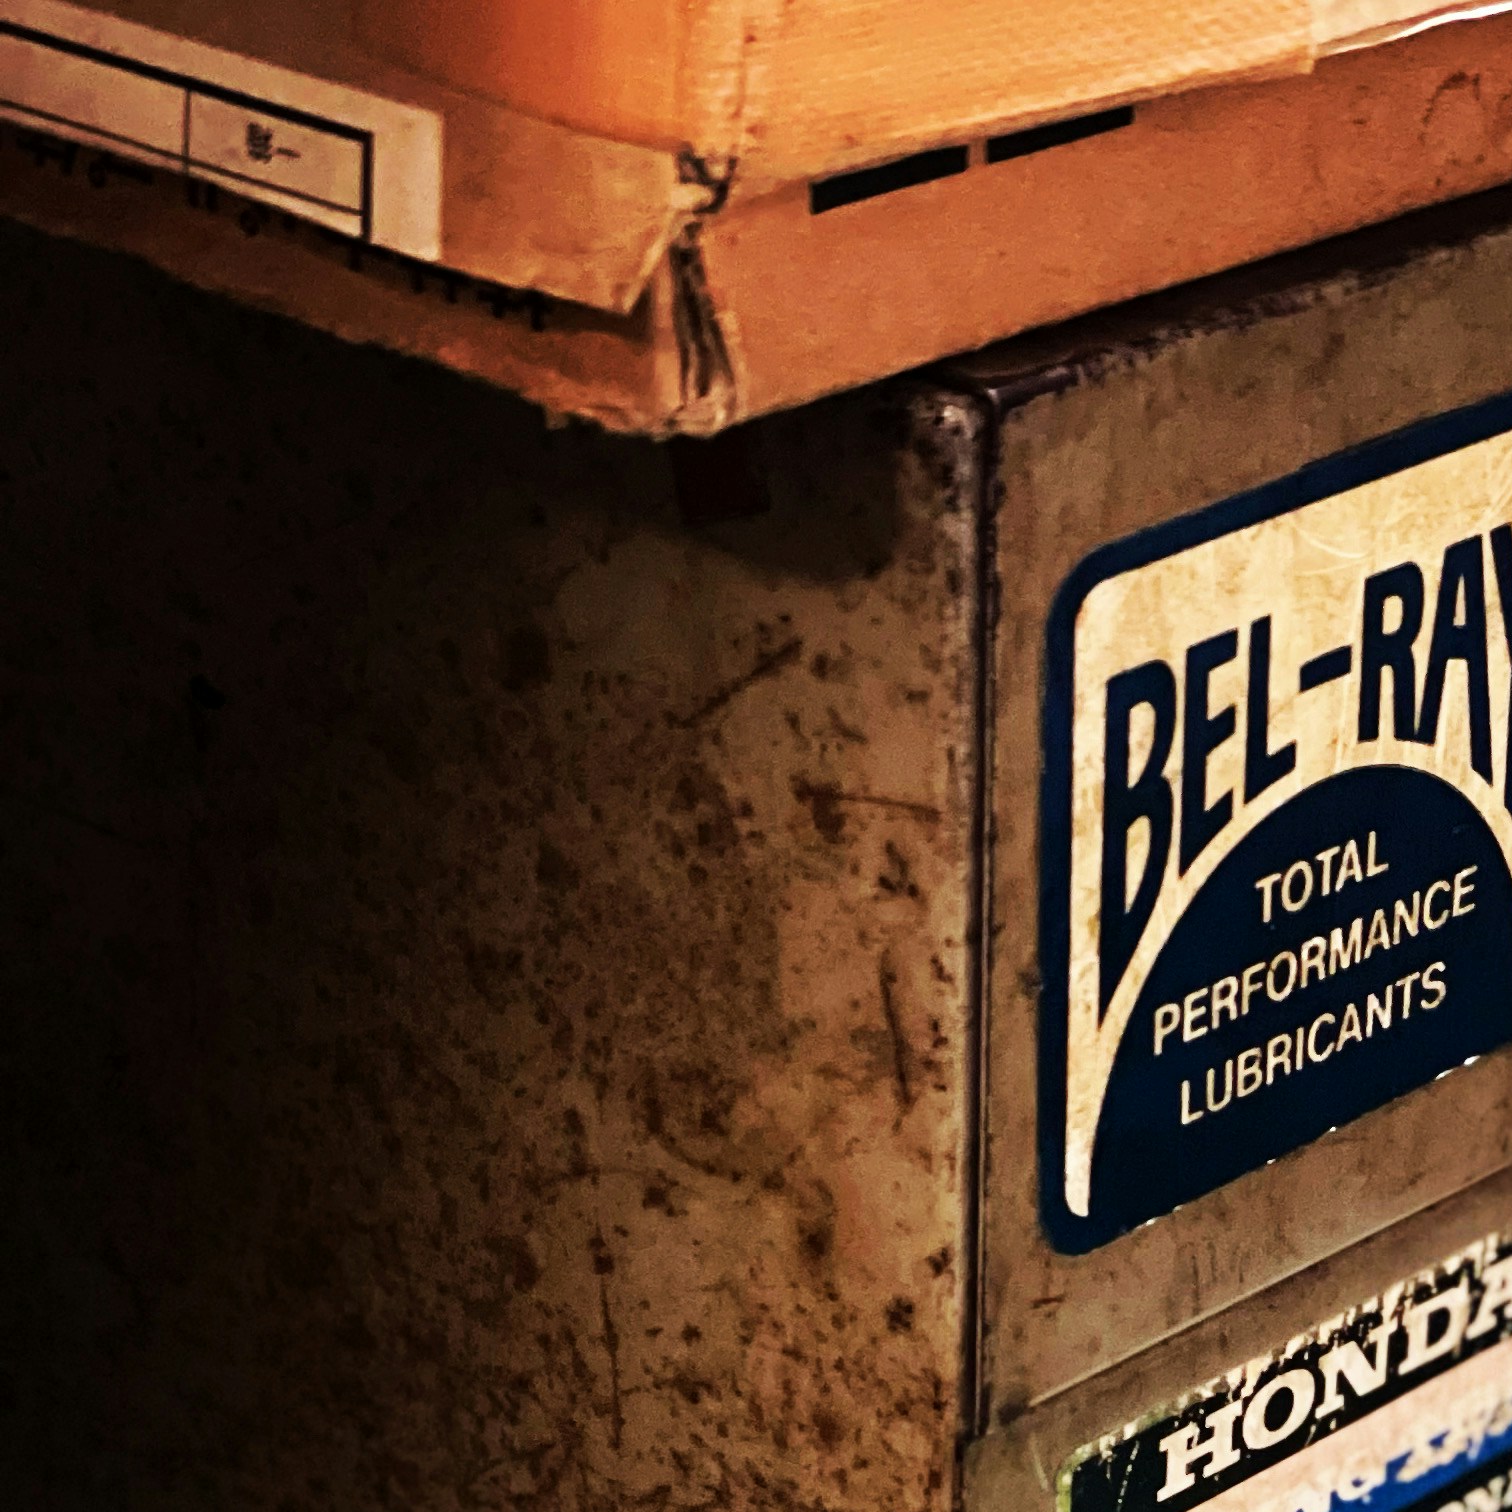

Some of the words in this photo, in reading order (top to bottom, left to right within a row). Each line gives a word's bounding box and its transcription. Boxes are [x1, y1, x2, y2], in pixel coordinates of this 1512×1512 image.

[1254, 830, 1390, 923] TOTAL
[1152, 865, 1479, 1057] PERFORMANCE
[1179, 961, 1447, 1126] LUBRICANTS
